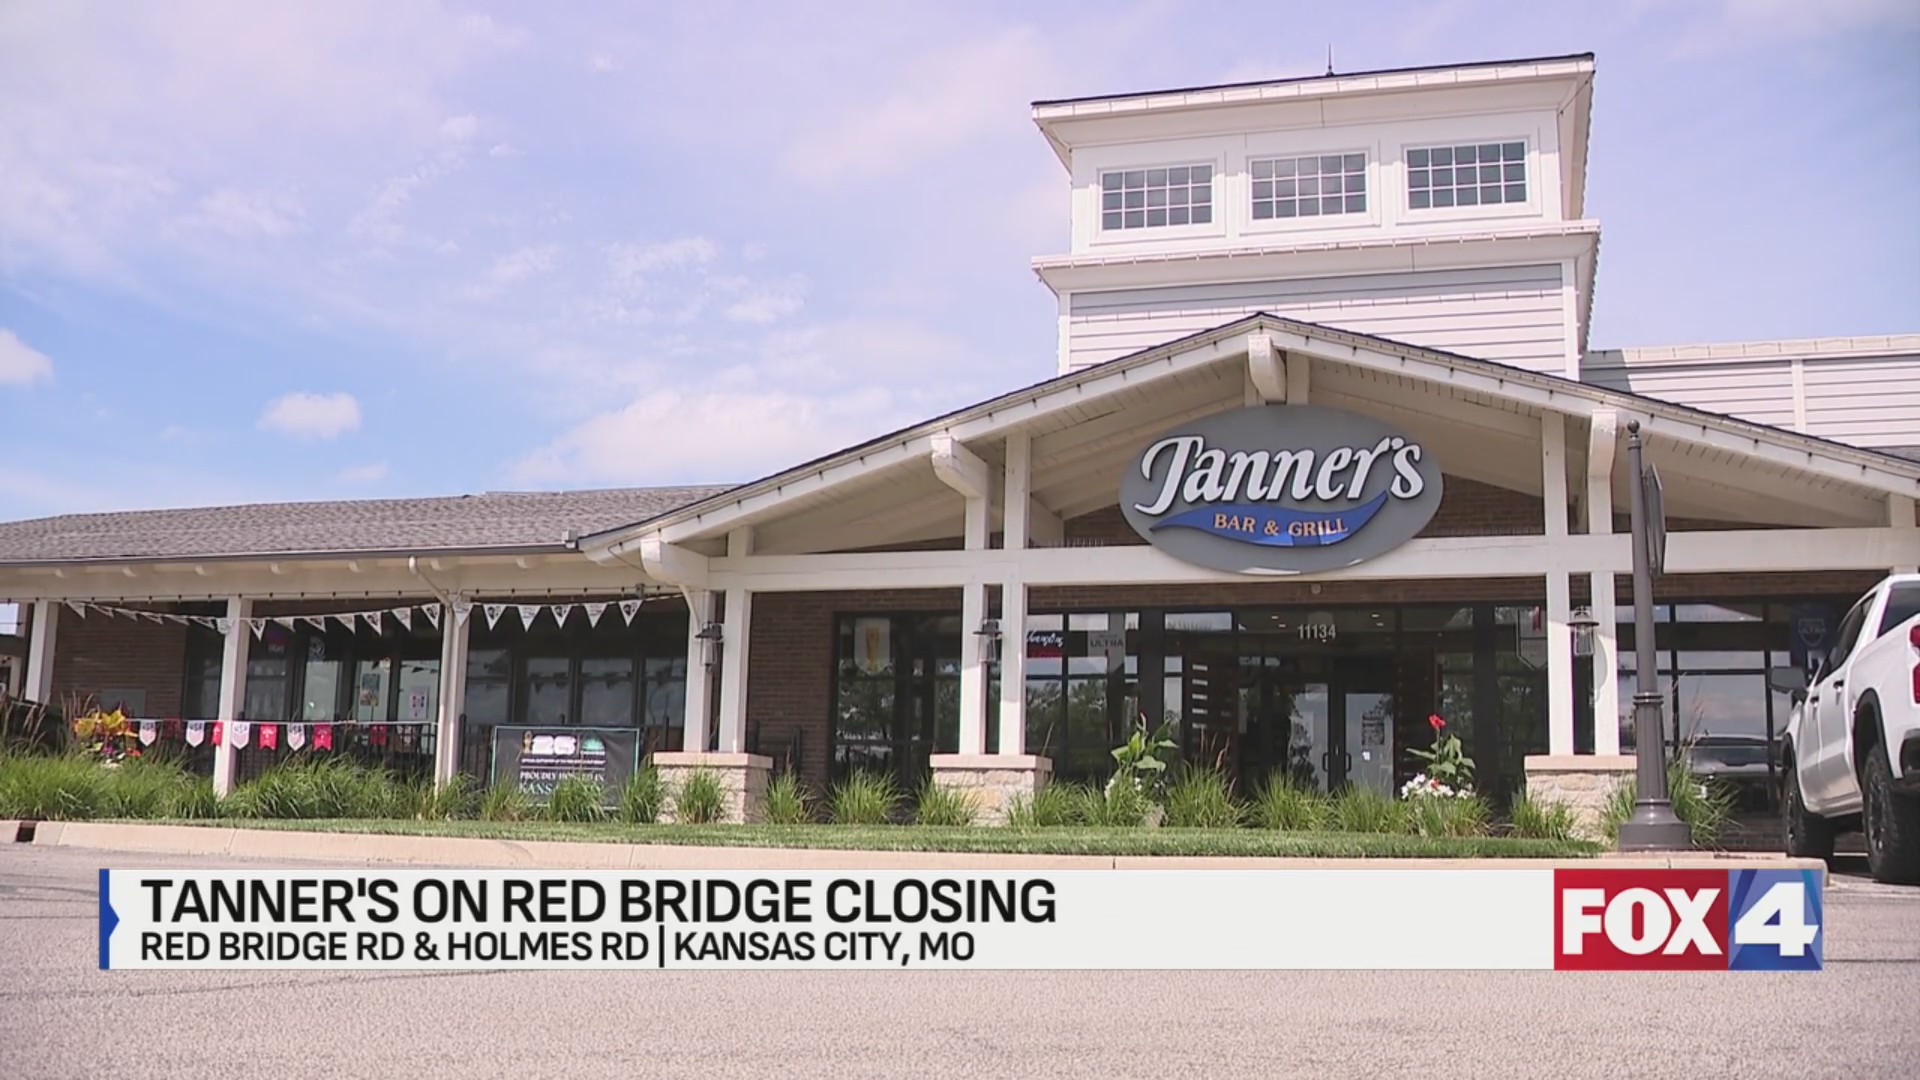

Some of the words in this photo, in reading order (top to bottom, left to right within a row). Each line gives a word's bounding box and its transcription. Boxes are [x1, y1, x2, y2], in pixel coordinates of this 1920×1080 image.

[1134, 434, 1425, 517] Tanner's
[1214, 513, 1256, 532] BAR
[1263, 521, 1279, 536] &
[1287, 518, 1349, 537] GRILL
[1297, 624, 1337, 640] 11134
[519, 771, 556, 781] PROUDLY
